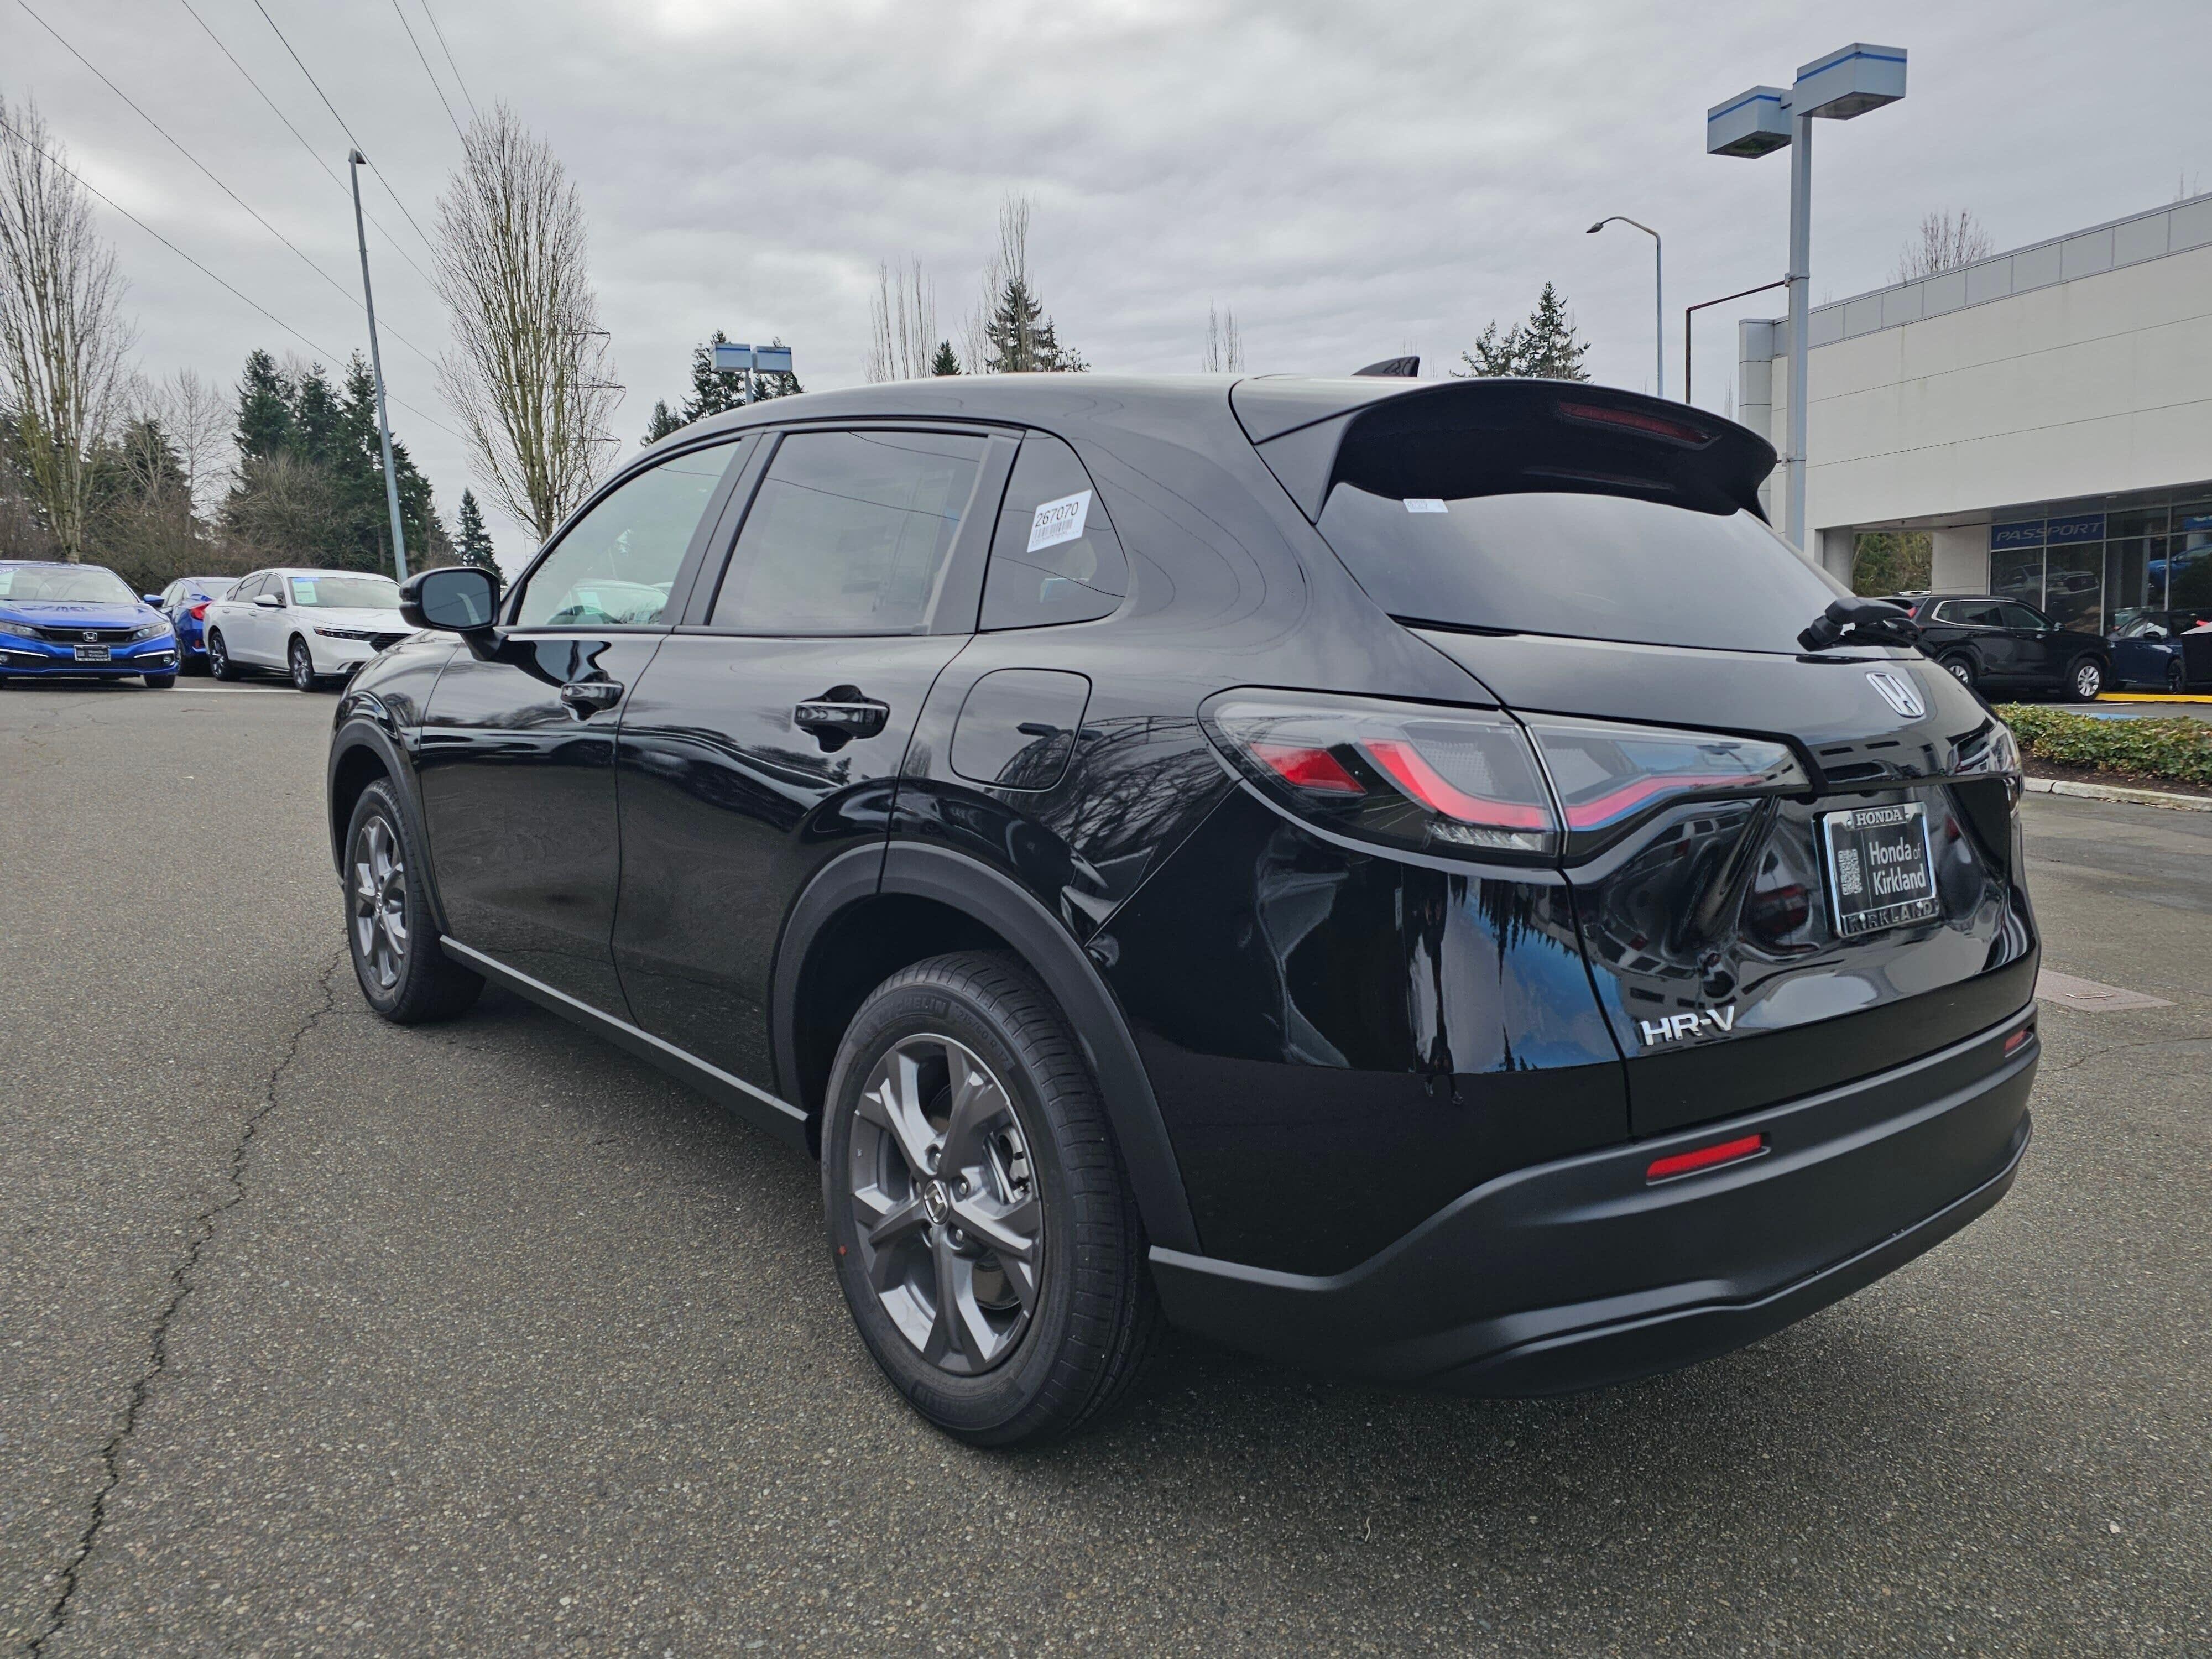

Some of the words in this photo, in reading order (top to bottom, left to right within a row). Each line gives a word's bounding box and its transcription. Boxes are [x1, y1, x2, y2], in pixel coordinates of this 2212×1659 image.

[1035, 502, 1079, 528] 267070
[1996, 521, 2105, 542] PASSPORT
[1855, 810, 1902, 826] HONDA
[1869, 837, 1912, 865] Honda
[1913, 843, 1921, 859] of
[1873, 863, 1926, 895] Kirkland
[1641, 1005, 1734, 1045] HR-V
